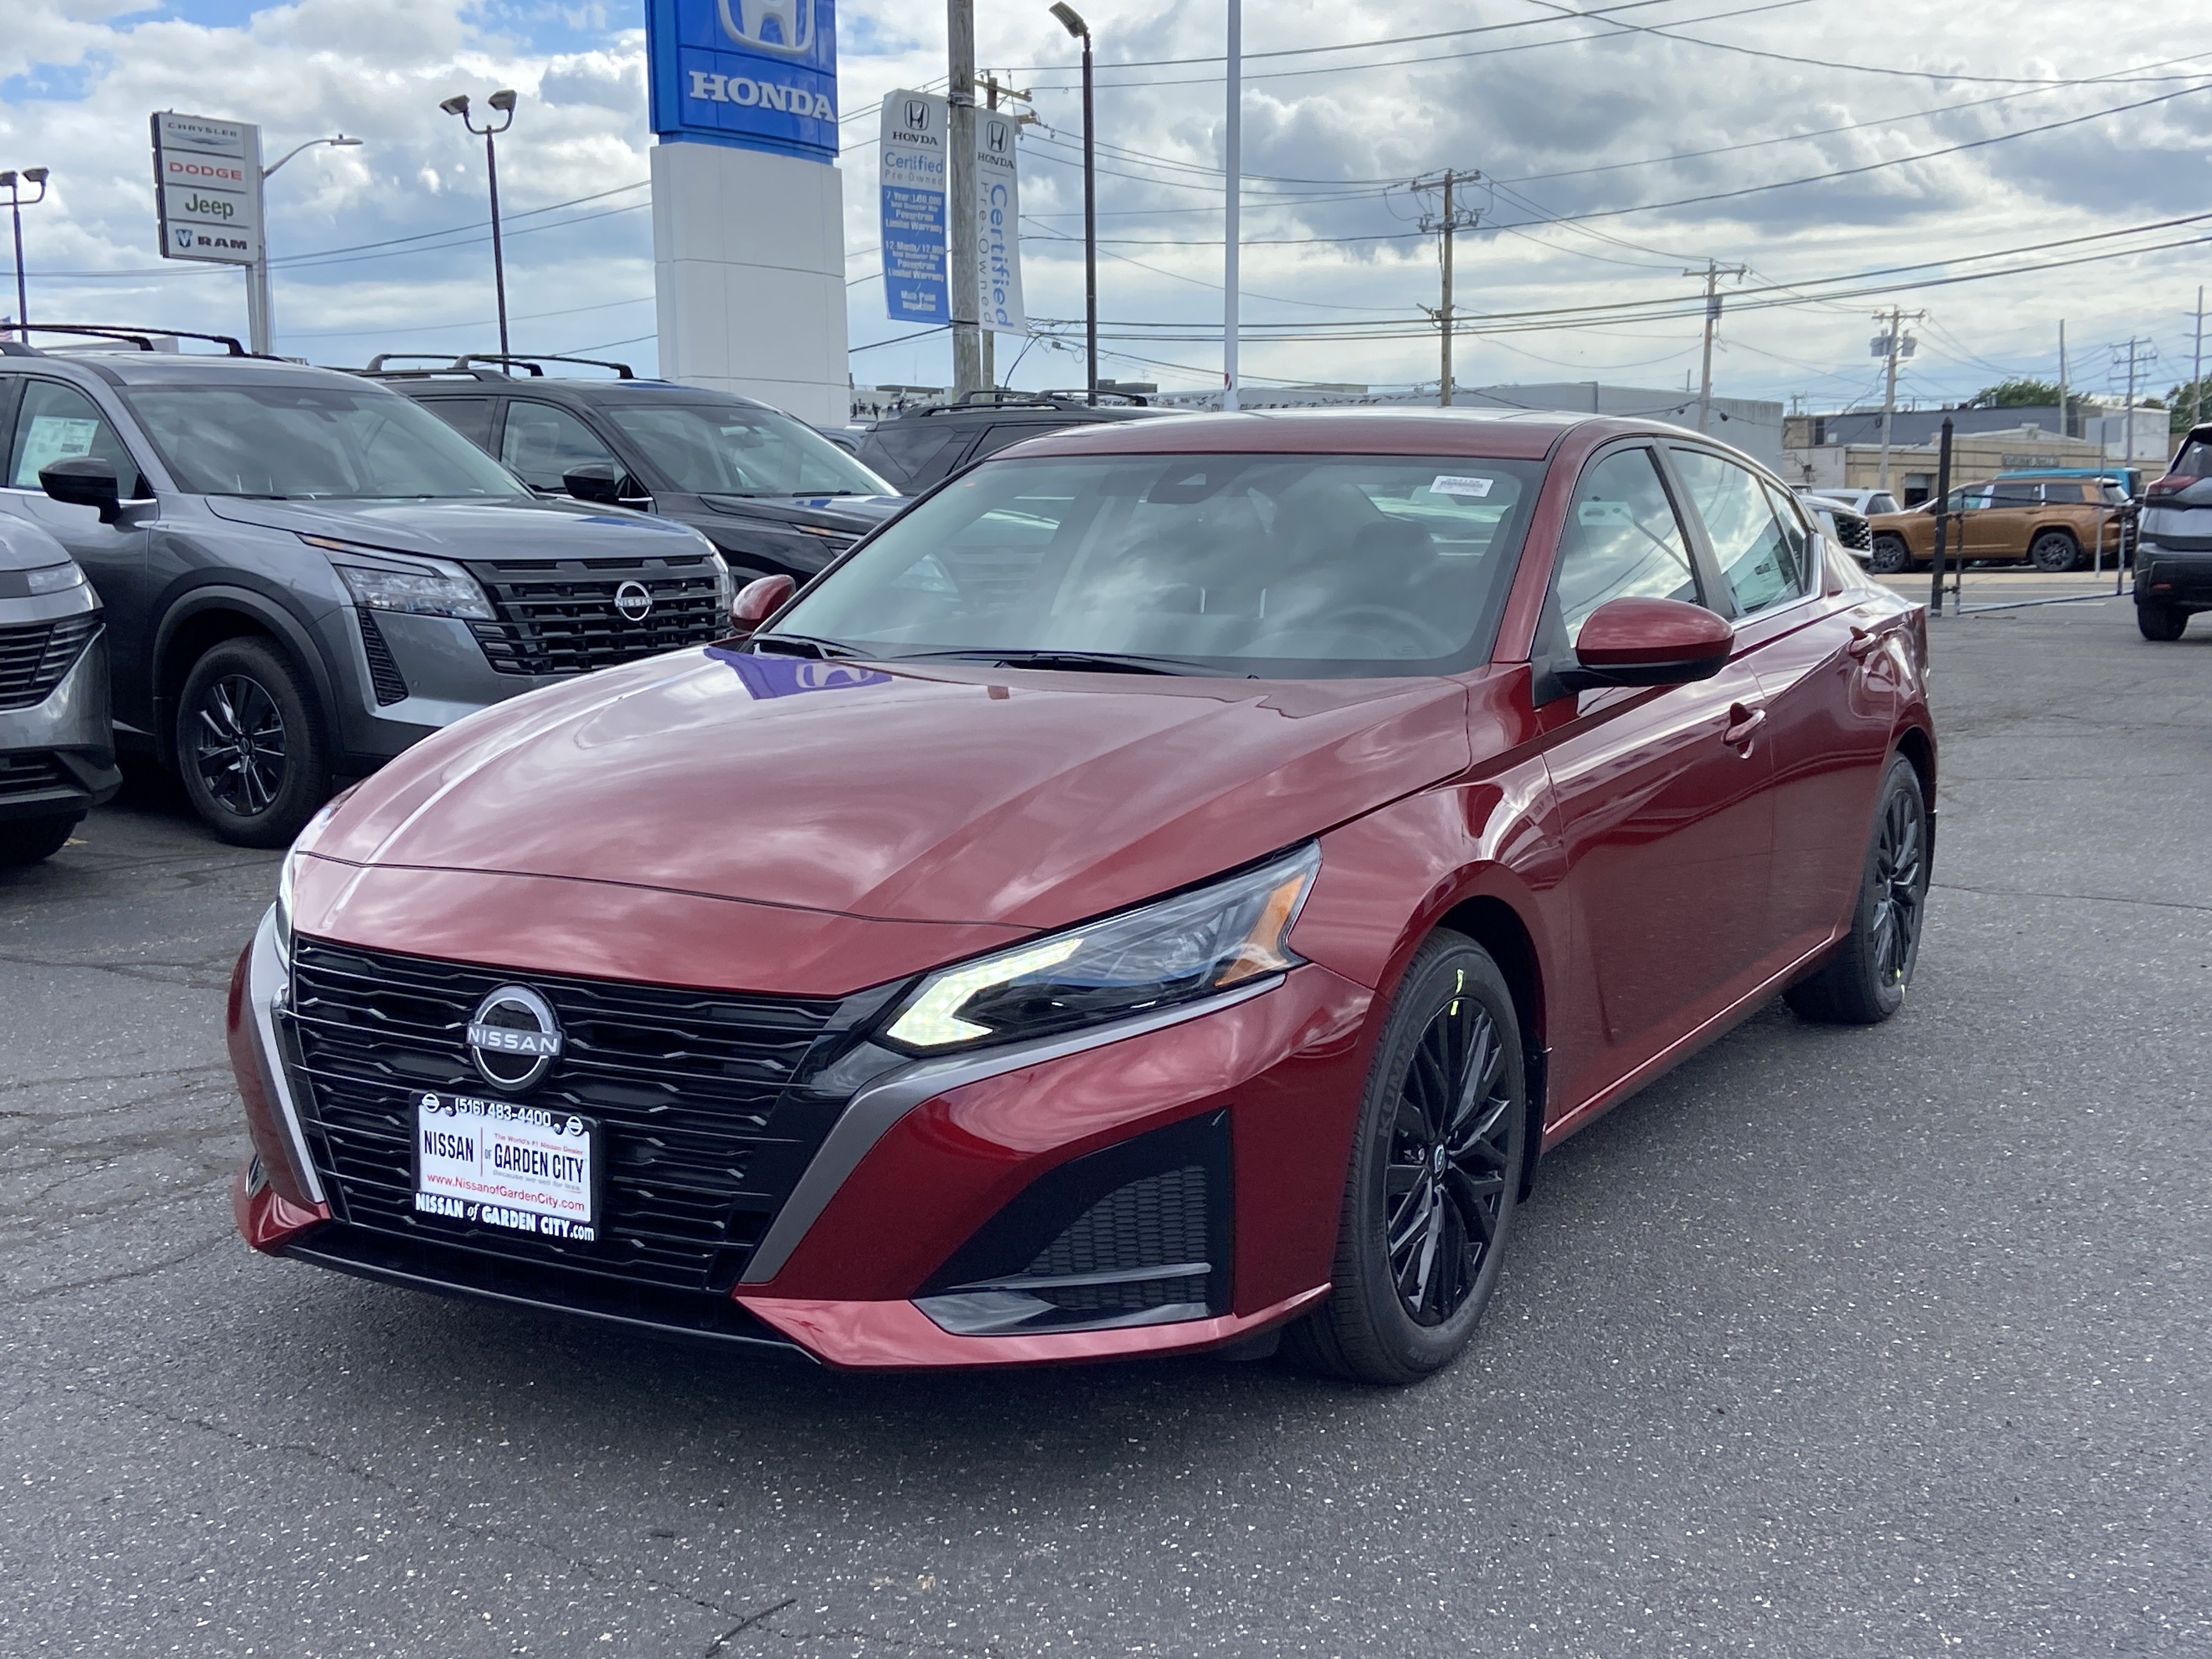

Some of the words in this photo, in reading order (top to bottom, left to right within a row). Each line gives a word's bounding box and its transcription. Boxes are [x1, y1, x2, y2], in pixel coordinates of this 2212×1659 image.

[689, 70, 837, 123] HONDA
[167, 122, 237, 137] CHRYSLER
[892, 131, 938, 145] HONDA
[885, 151, 943, 173] Certified
[978, 151, 1014, 169] HONDA
[169, 162, 242, 181] DODGE
[885, 169, 943, 185] Pre-Owned
[185, 193, 234, 220] Jeep
[198, 236, 247, 250] RAM
[885, 240, 894, 250] 12
[978, 181, 995, 324] Pre-Owned
[990, 184, 1014, 328] Certified
[616, 599, 652, 607] NISSAN
[467, 1026, 558, 1053] NISSAN
[455, 1097, 485, 1116] (516)
[488, 1103, 551, 1127] 483-4400
[494, 1132, 505, 1141] The
[507, 1135, 530, 1145] World's
[540, 1141, 561, 1150] Nissan
[563, 1146, 583, 1155] Dealer
[424, 1130, 473, 1163] NISSAN
[495, 1143, 548, 1177] GARDEN
[552, 1154, 584, 1183] CITY
[493, 1169, 523, 1180] Because
[427, 1173, 584, 1211] www.NissanofGardenCity.com
[415, 1193, 464, 1218] NISSAN
[467, 1203, 481, 1221] of
[482, 1205, 536, 1232] GARDEN
[540, 1216, 595, 1242] CITY.com
